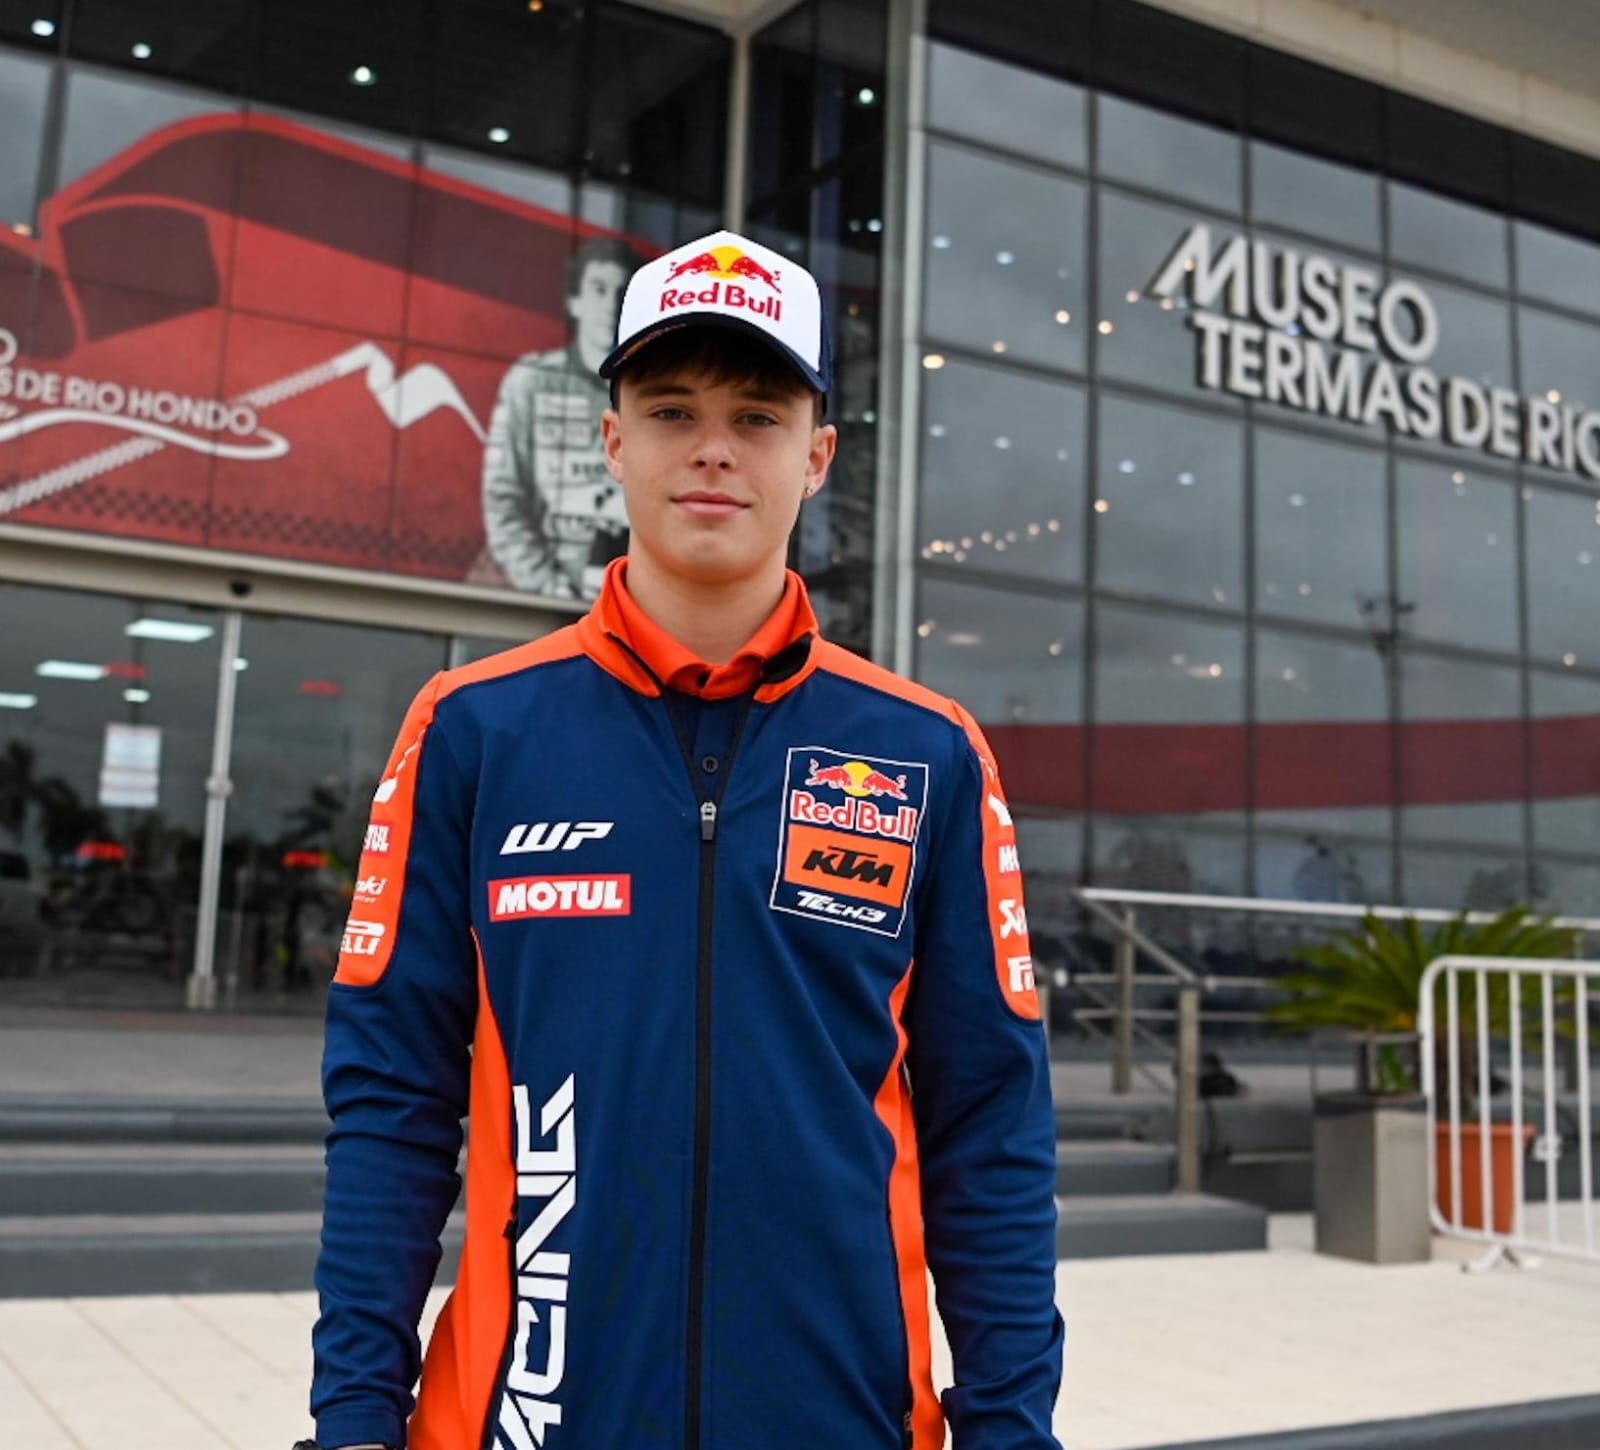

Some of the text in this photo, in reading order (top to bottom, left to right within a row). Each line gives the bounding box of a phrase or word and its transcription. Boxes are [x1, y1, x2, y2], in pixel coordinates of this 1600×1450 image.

[659, 281, 783, 321] Red Bull
[1154, 223, 1440, 364] MUSEO
[15, 367, 60, 404] DE
[64, 376, 126, 415] RIO
[128, 387, 257, 436] HONDO
[1193, 310, 1443, 440] TERMAS
[1447, 375, 1521, 459] DE
[499, 821, 615, 855] WP
[790, 789, 918, 842] Red Bull
[802, 845, 895, 889] KTM
[496, 880, 624, 916] MOTUL
